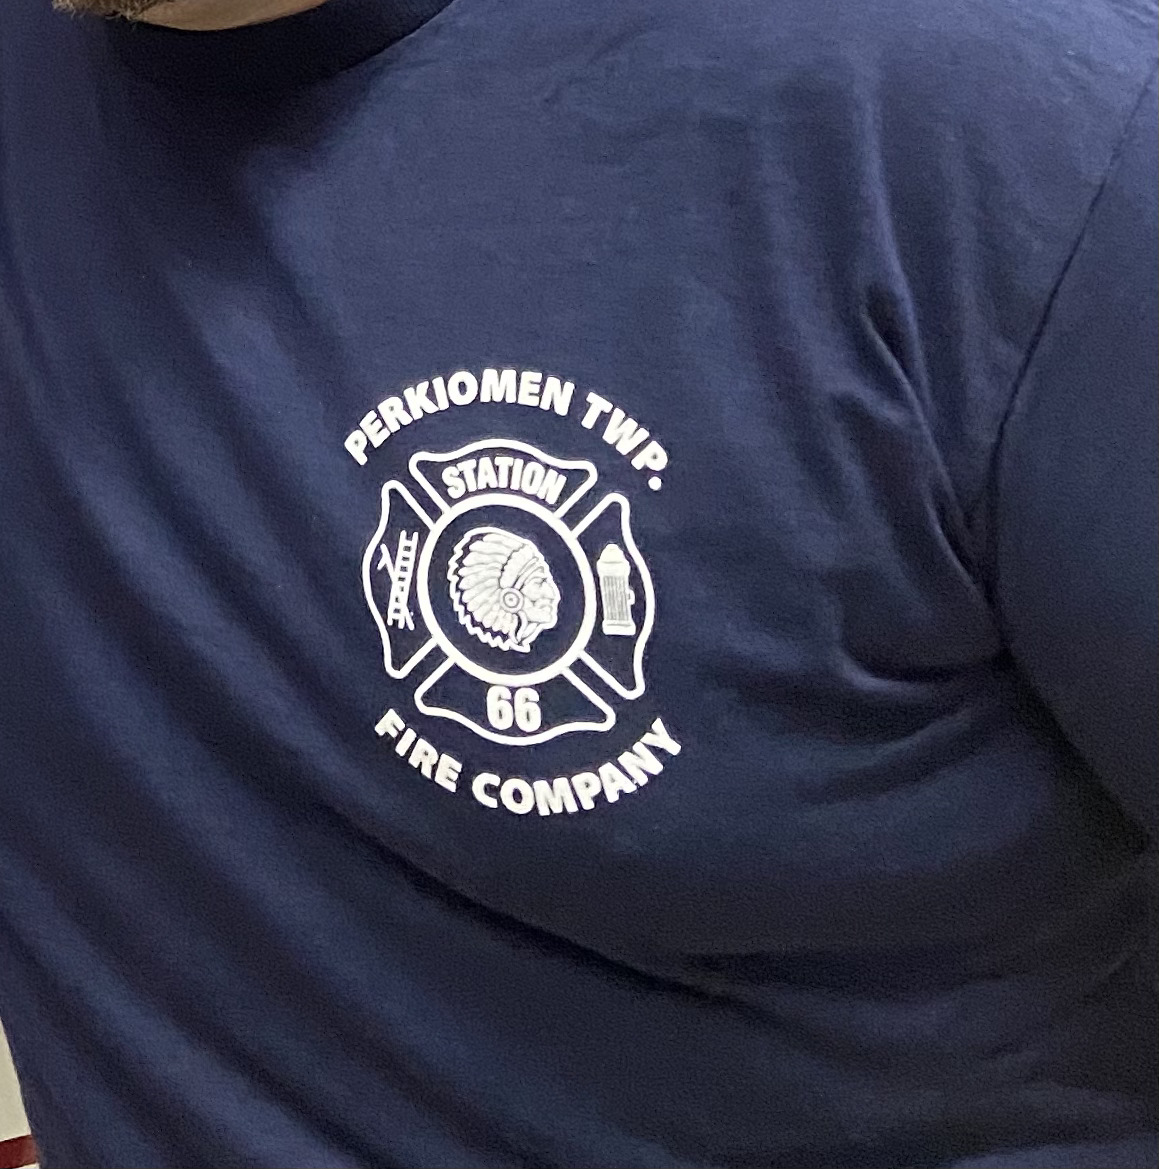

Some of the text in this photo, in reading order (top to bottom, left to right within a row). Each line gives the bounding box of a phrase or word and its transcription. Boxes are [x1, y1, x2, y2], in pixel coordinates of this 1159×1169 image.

[344, 368, 669, 492] PERKIOMEN TWP.
[441, 456, 567, 505] STATION
[486, 685, 542, 732] 66
[374, 708, 683, 817] FIRE COMPANY
